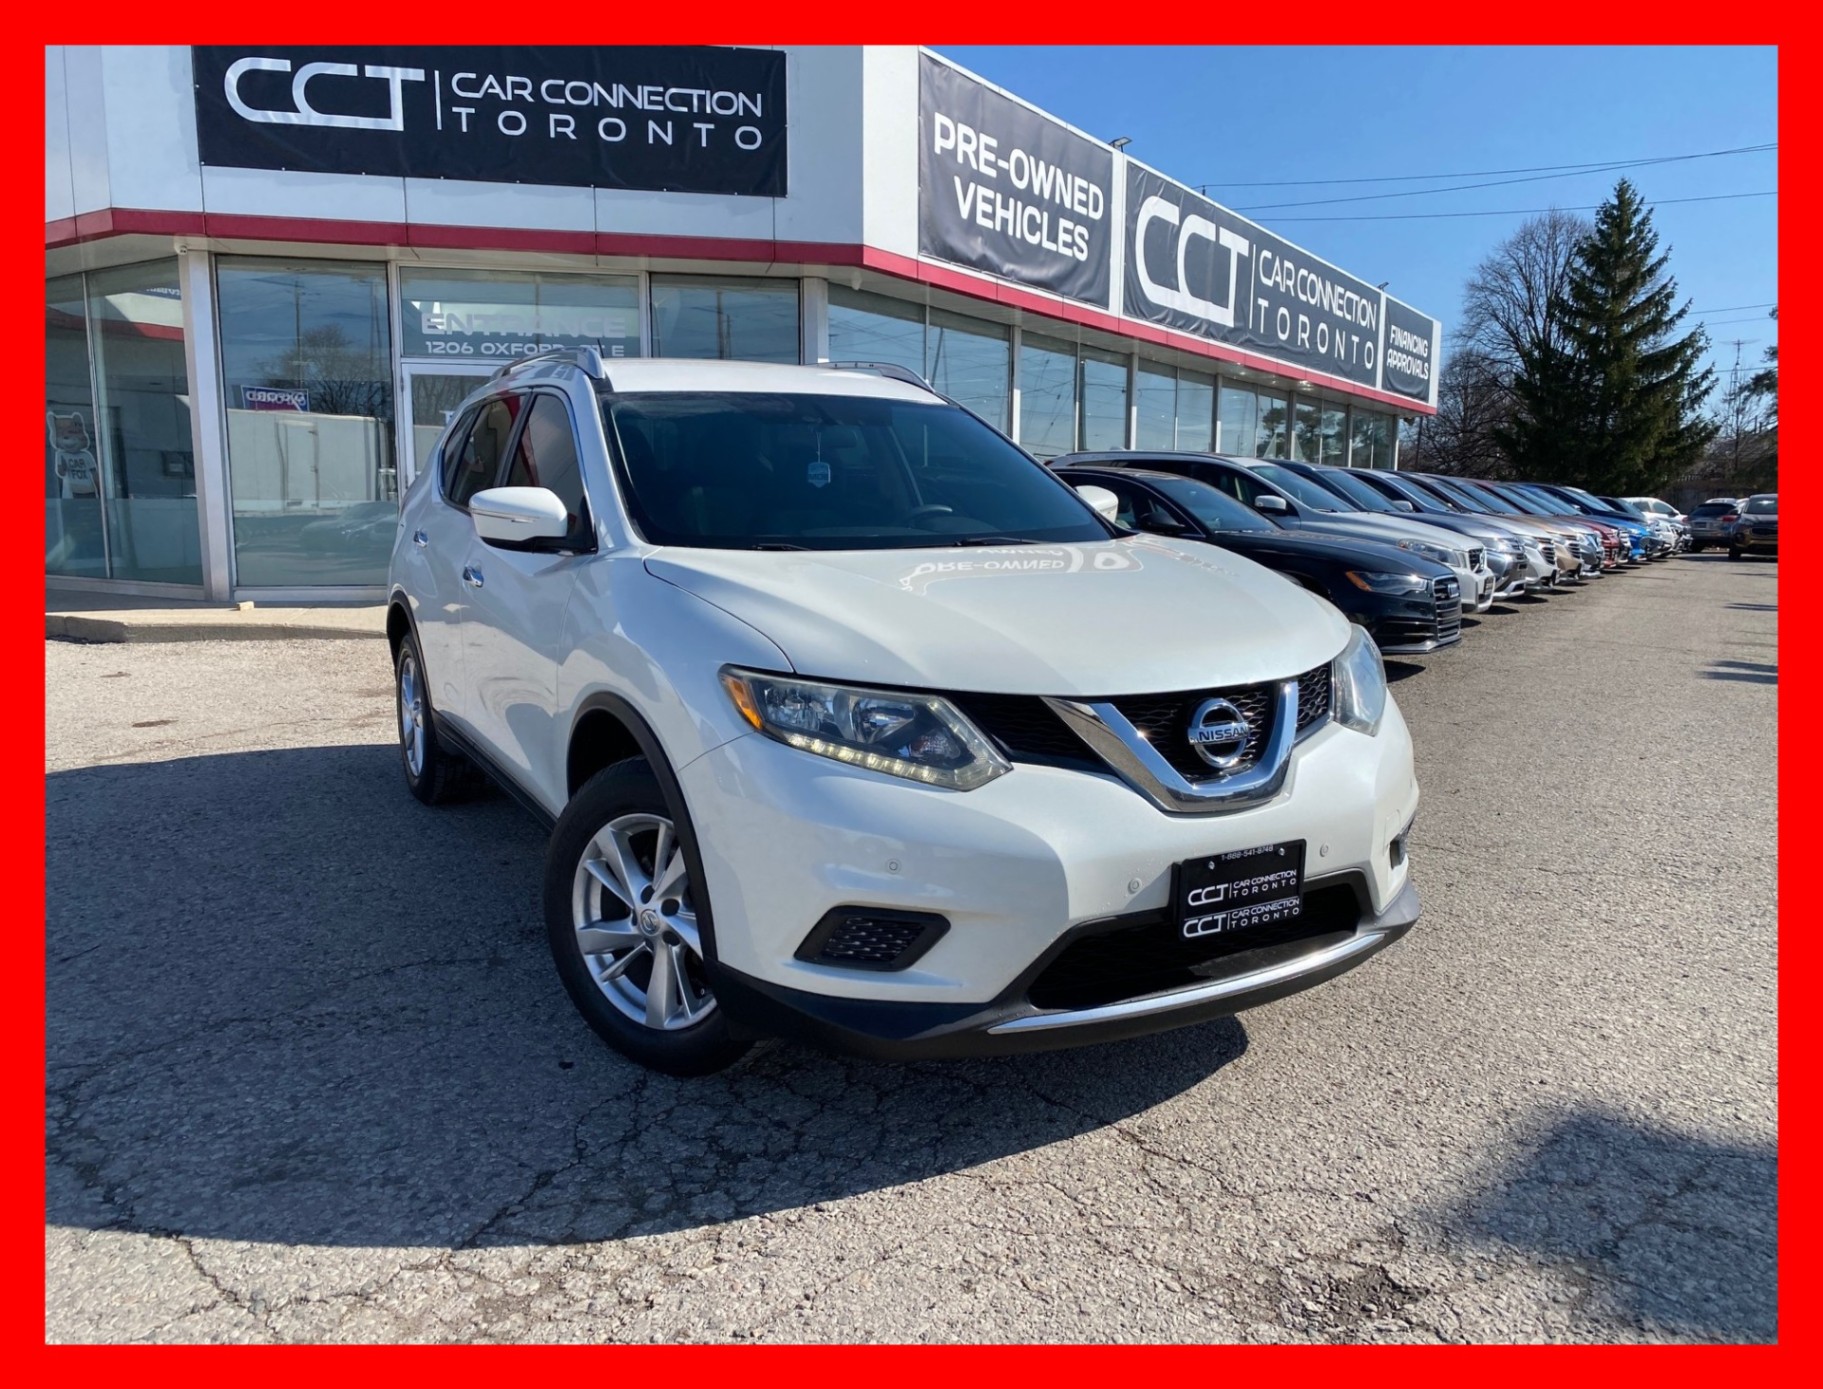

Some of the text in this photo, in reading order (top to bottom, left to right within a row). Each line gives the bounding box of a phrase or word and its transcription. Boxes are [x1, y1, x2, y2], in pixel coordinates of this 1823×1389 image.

[224, 57, 425, 131] CCT
[451, 72, 762, 117] CAR CONNECTION
[452, 107, 762, 150] TORONTO
[934, 112, 1103, 220] PRE-OWNED
[954, 175, 1089, 261] VEHICLES
[1135, 196, 1249, 328] CCT
[1259, 250, 1377, 331] CAR CONNECTION
[421, 312, 626, 338] ENTRANCE
[1257, 298, 1374, 370] TORONTO
[1390, 324, 1428, 358] FINANCING
[425, 341, 473, 354] 1206
[611, 345, 625, 357] E
[1387, 348, 1429, 380] APPROVALS
[1198, 726, 1247, 741] NISSAN
[1187, 883, 1228, 906] CCT
[1233, 869, 1297, 889] CAR CONNECTION
[1233, 878, 1297, 898] TORONTO
[1231, 898, 1299, 919] CAR CONNECTION
[1231, 907, 1300, 929] TORONTO
[1183, 914, 1227, 938] CCT
